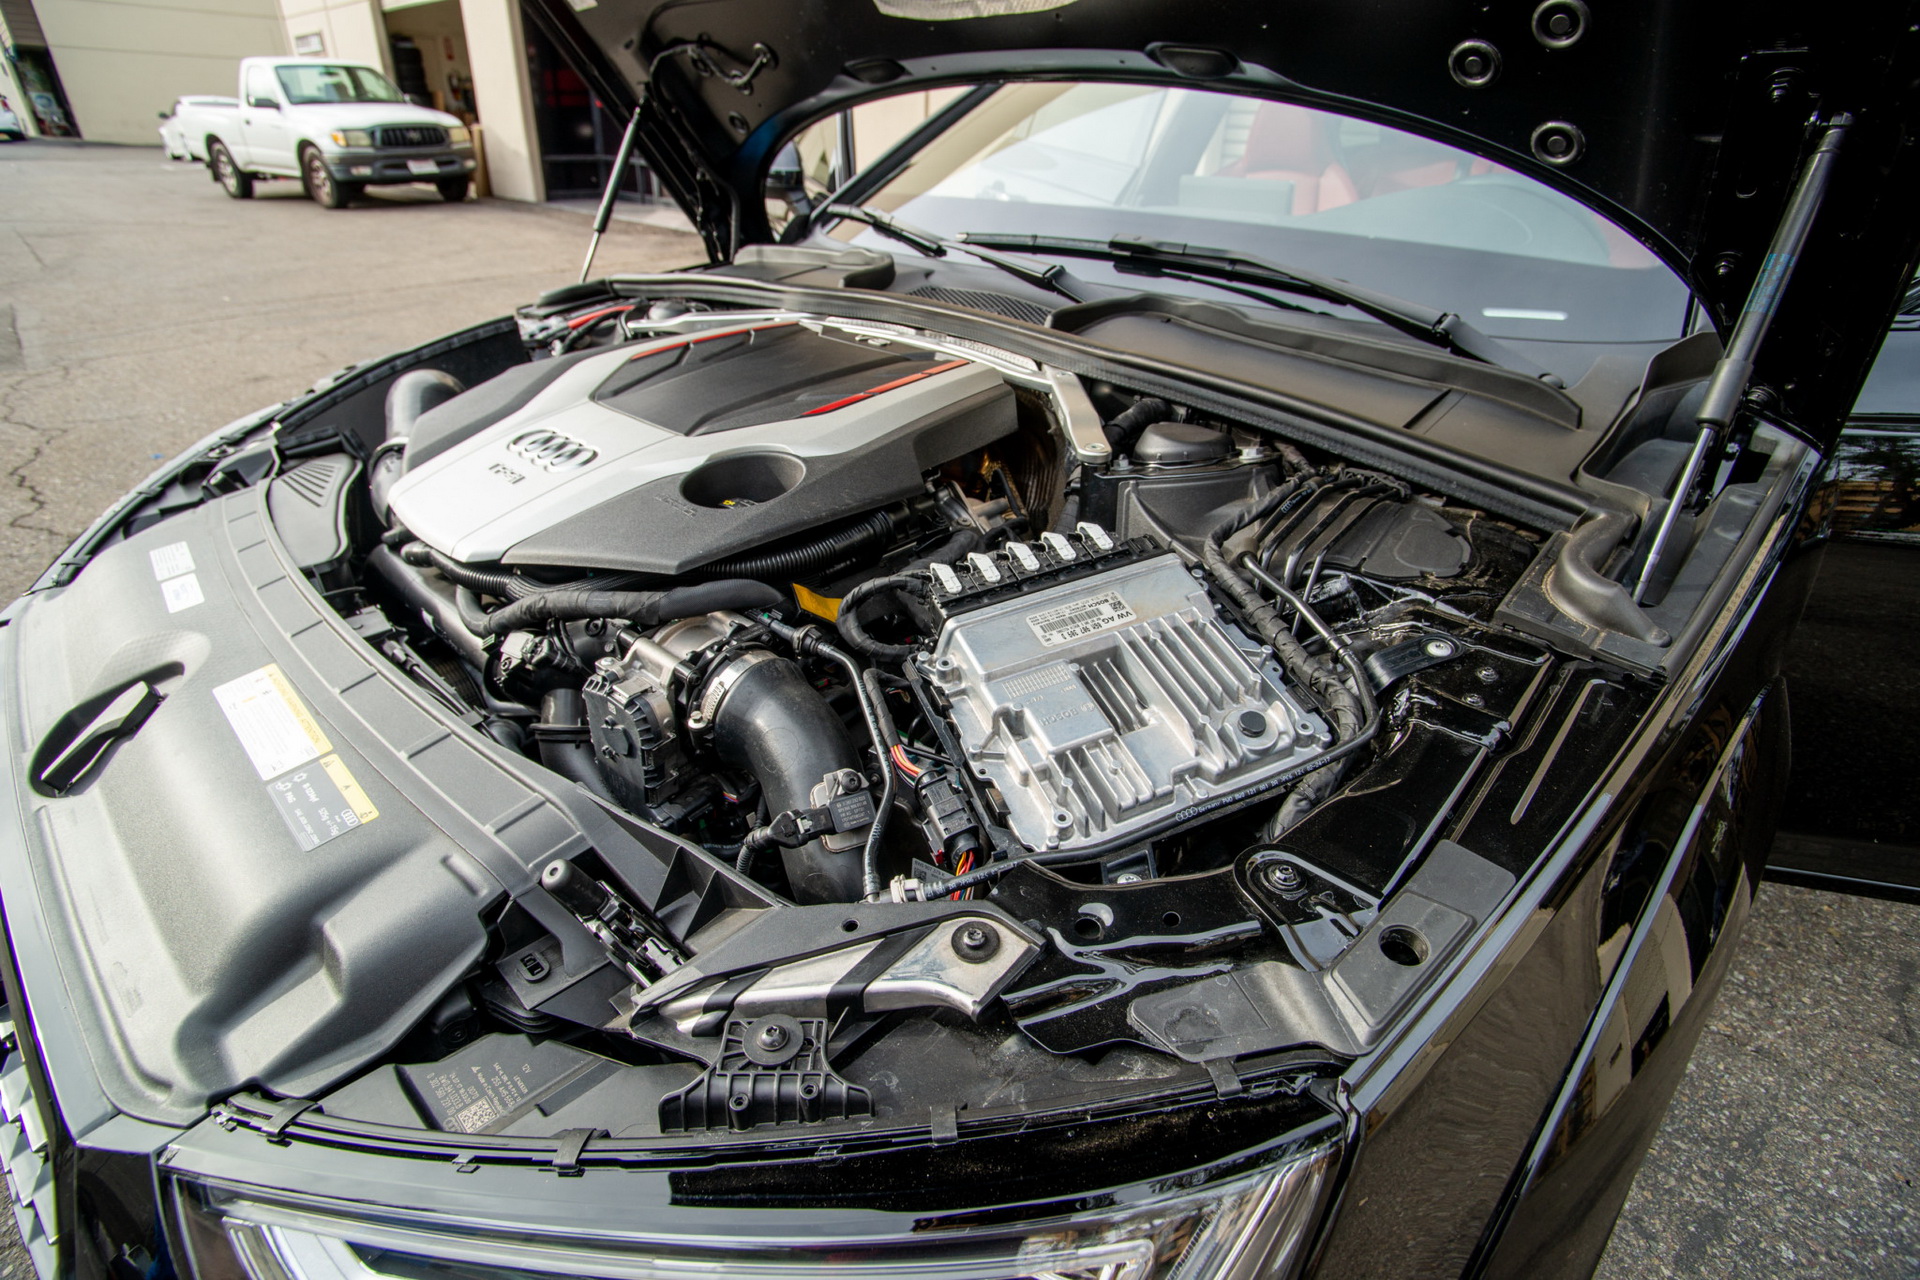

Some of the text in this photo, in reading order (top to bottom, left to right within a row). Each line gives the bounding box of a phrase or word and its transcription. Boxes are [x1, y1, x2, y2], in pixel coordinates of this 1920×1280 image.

[1087, 597, 1109, 608] BOSCH
[1116, 609, 1132, 619] VW
[1100, 615, 1115, 625] AG
[1038, 707, 1078, 726] BOSCH
[522, 1063, 532, 1073] 12V
